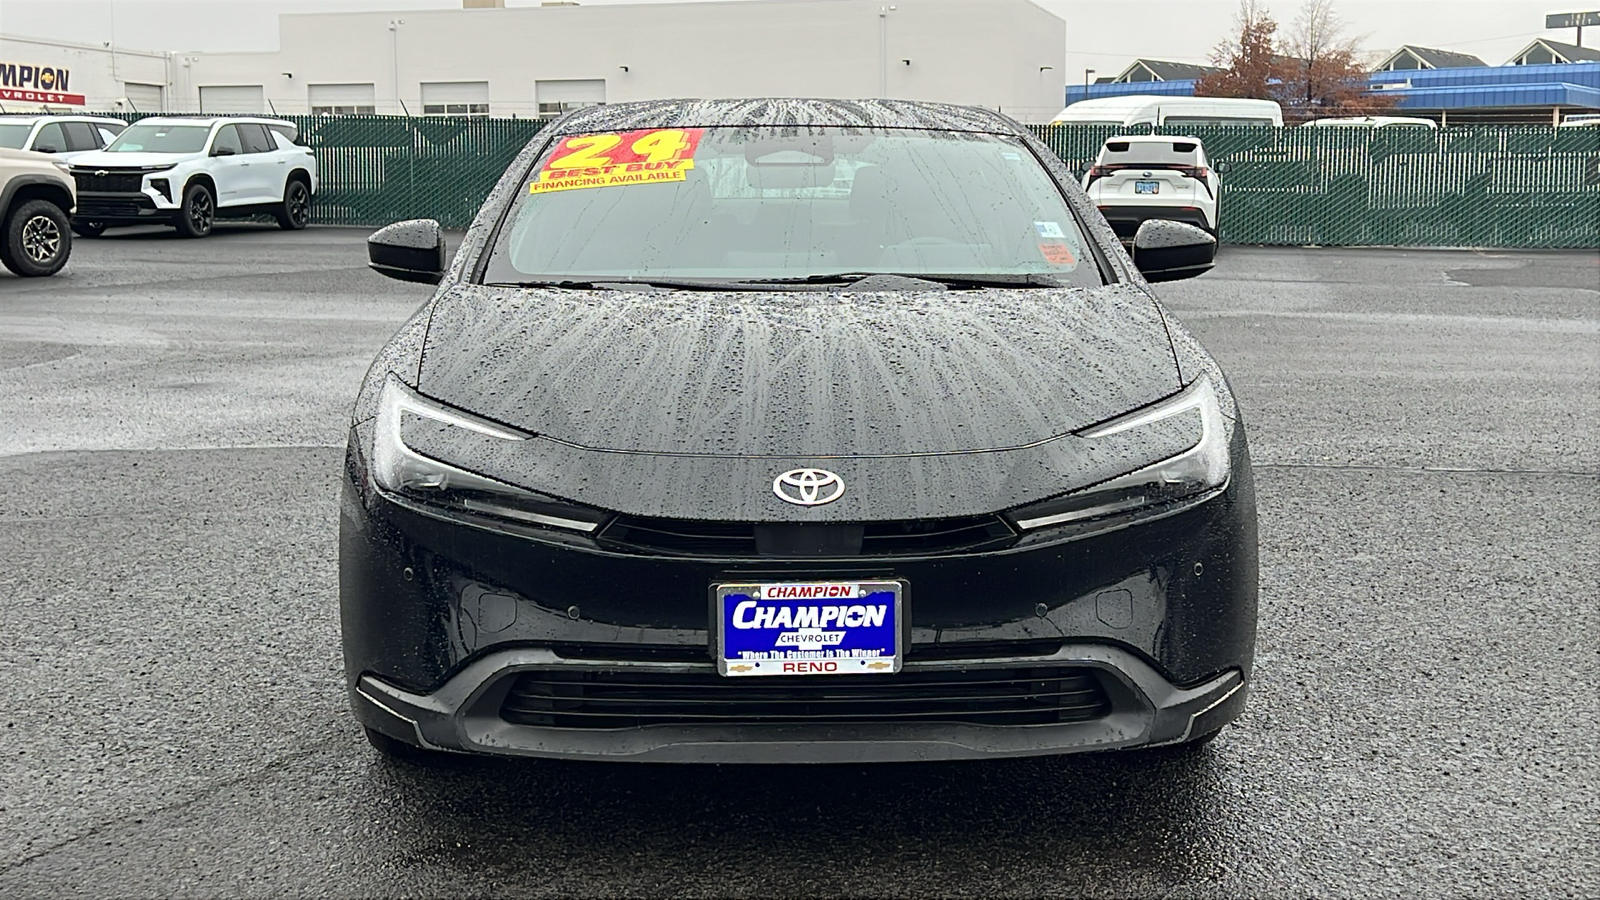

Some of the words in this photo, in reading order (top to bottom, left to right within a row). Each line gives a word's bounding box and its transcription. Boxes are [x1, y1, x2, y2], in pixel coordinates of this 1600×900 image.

[0, 63, 70, 92] MPION
[2, 91, 65, 102] VROLET
[549, 129, 692, 169] 24
[548, 165, 617, 180] BEST
[625, 160, 685, 173] BUY
[534, 177, 606, 191] FINANCING
[609, 171, 682, 184] AVAILABLE
[767, 586, 852, 598] CHAMPION
[732, 600, 887, 629] CHAMPION
[780, 633, 840, 643] CHEVROLET
[770, 650, 786, 660] The
[786, 650, 825, 659] Customer
[835, 649, 851, 658] The
[783, 662, 838, 672] RENO
